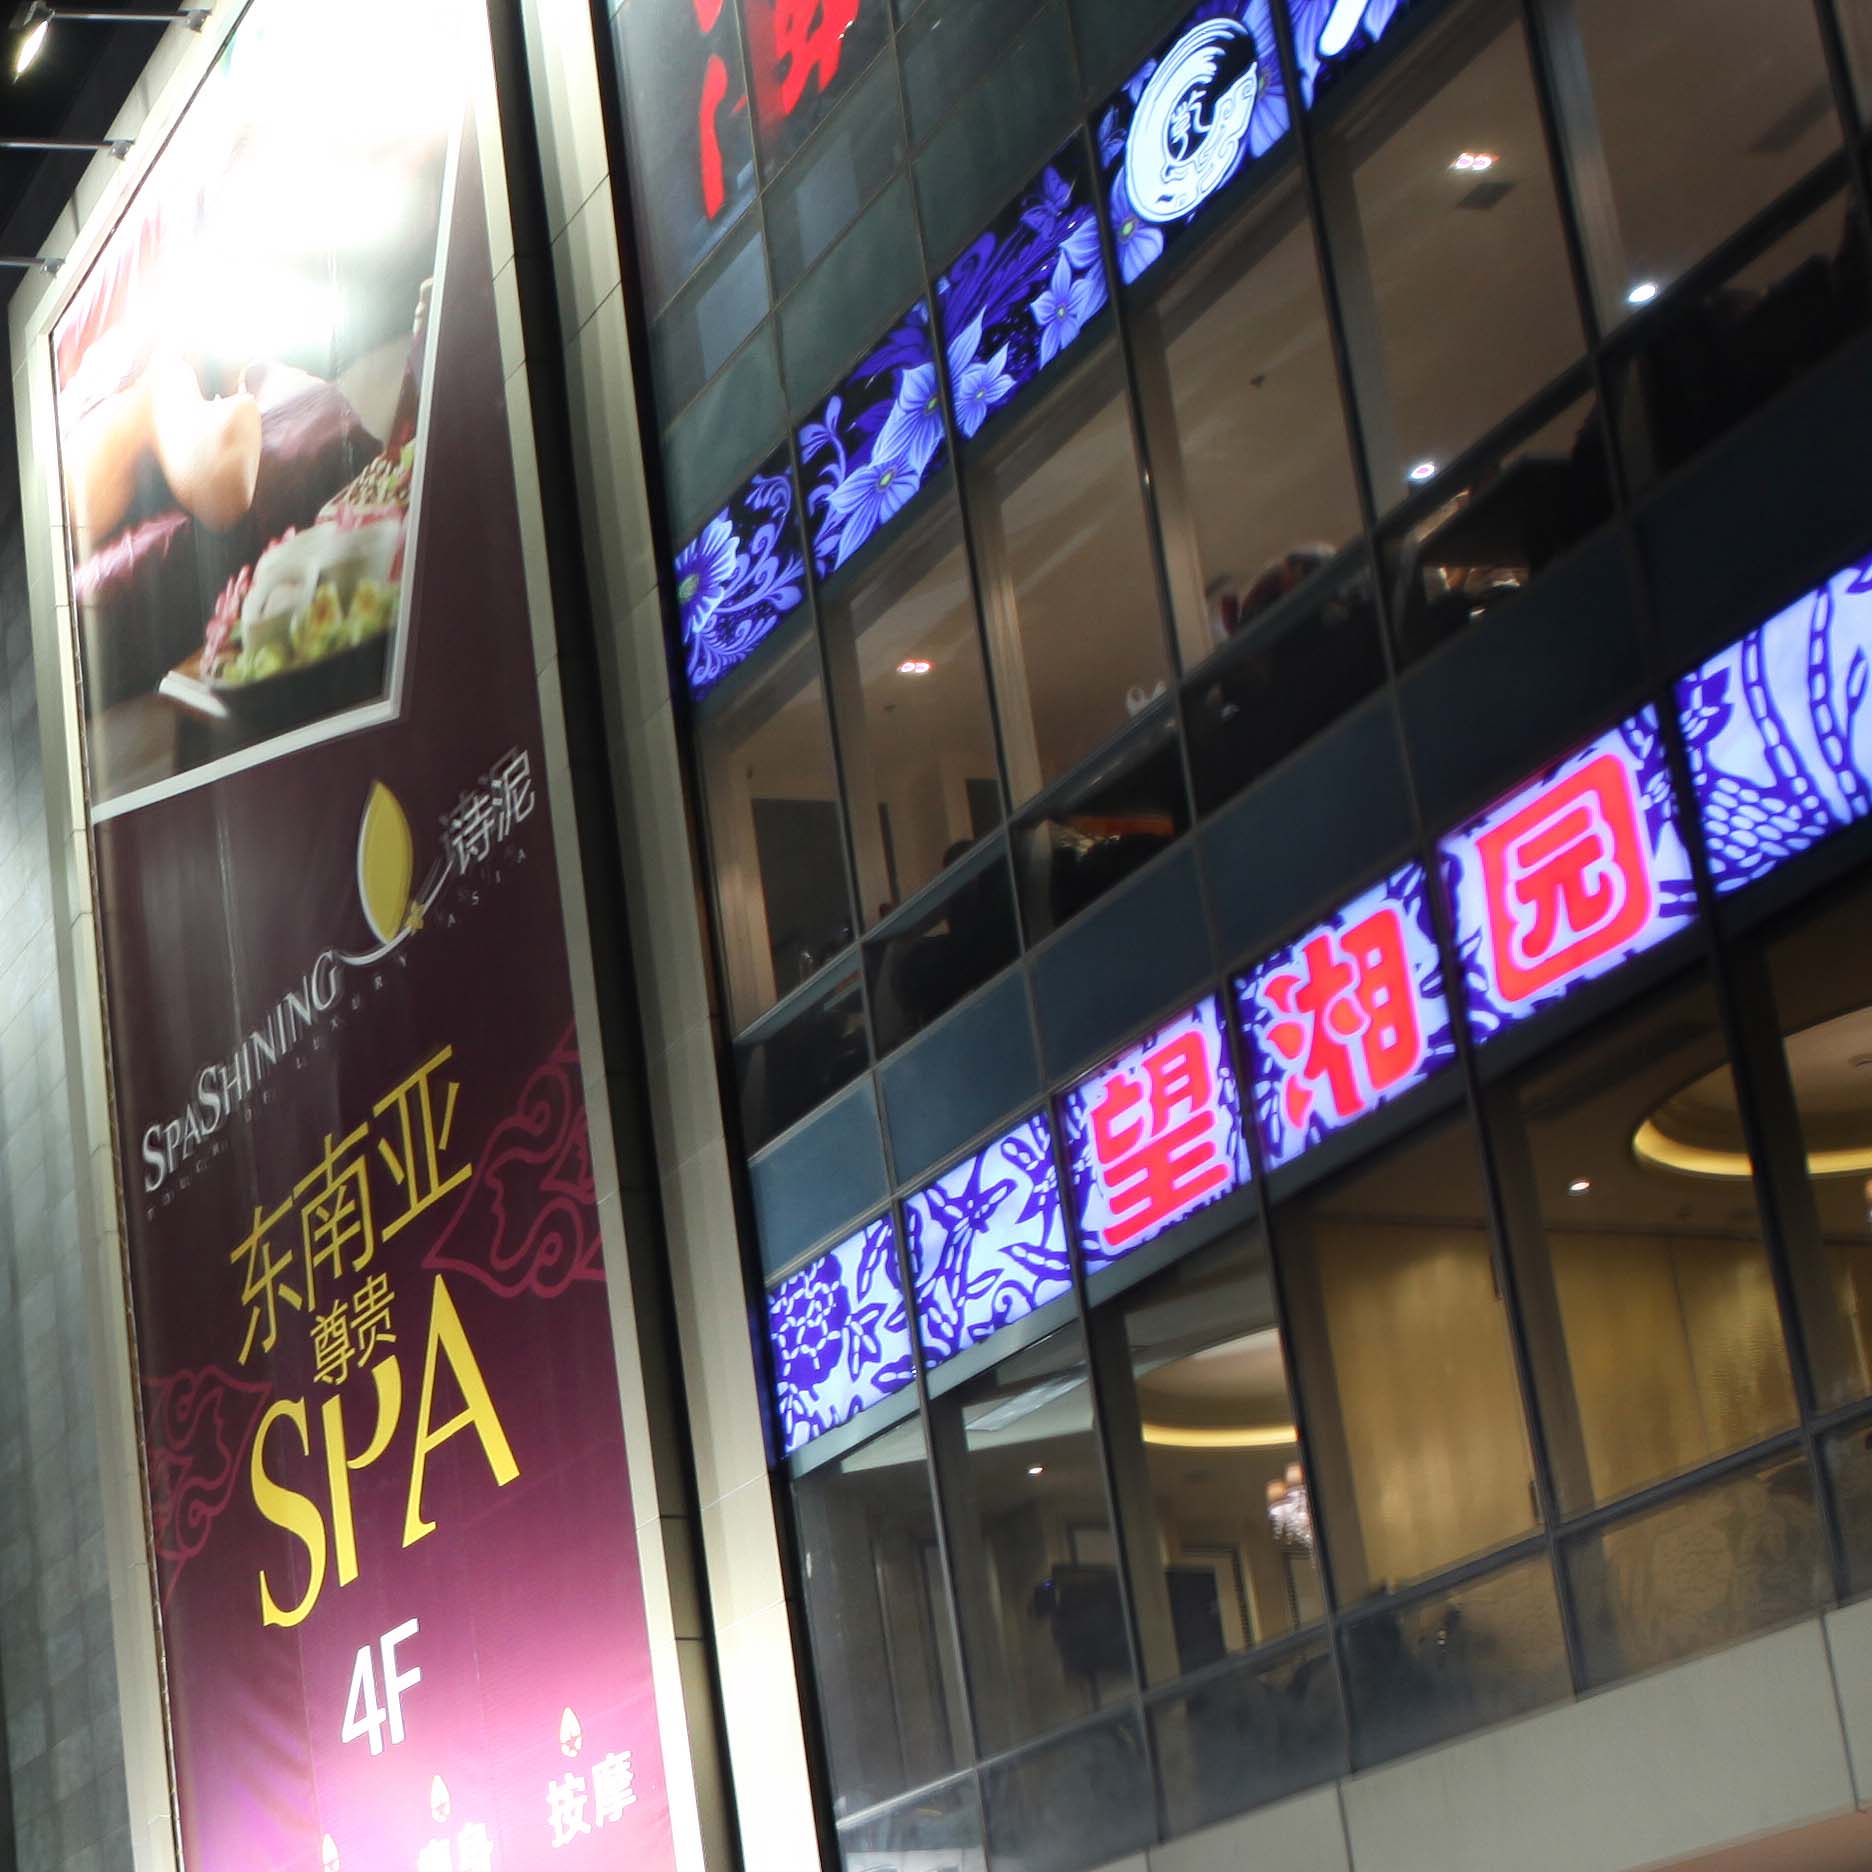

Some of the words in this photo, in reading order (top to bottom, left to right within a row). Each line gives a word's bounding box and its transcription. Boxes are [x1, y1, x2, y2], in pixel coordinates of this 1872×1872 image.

[1093, 752, 1652, 1250] 望湘园
[230, 1045, 473, 1366] 东南亚
[310, 1274, 397, 1385] 尊贵
[250, 1274, 521, 1628] SPA
[341, 1618, 422, 1757] 4F
[546, 1750, 638, 1848] 按摩
